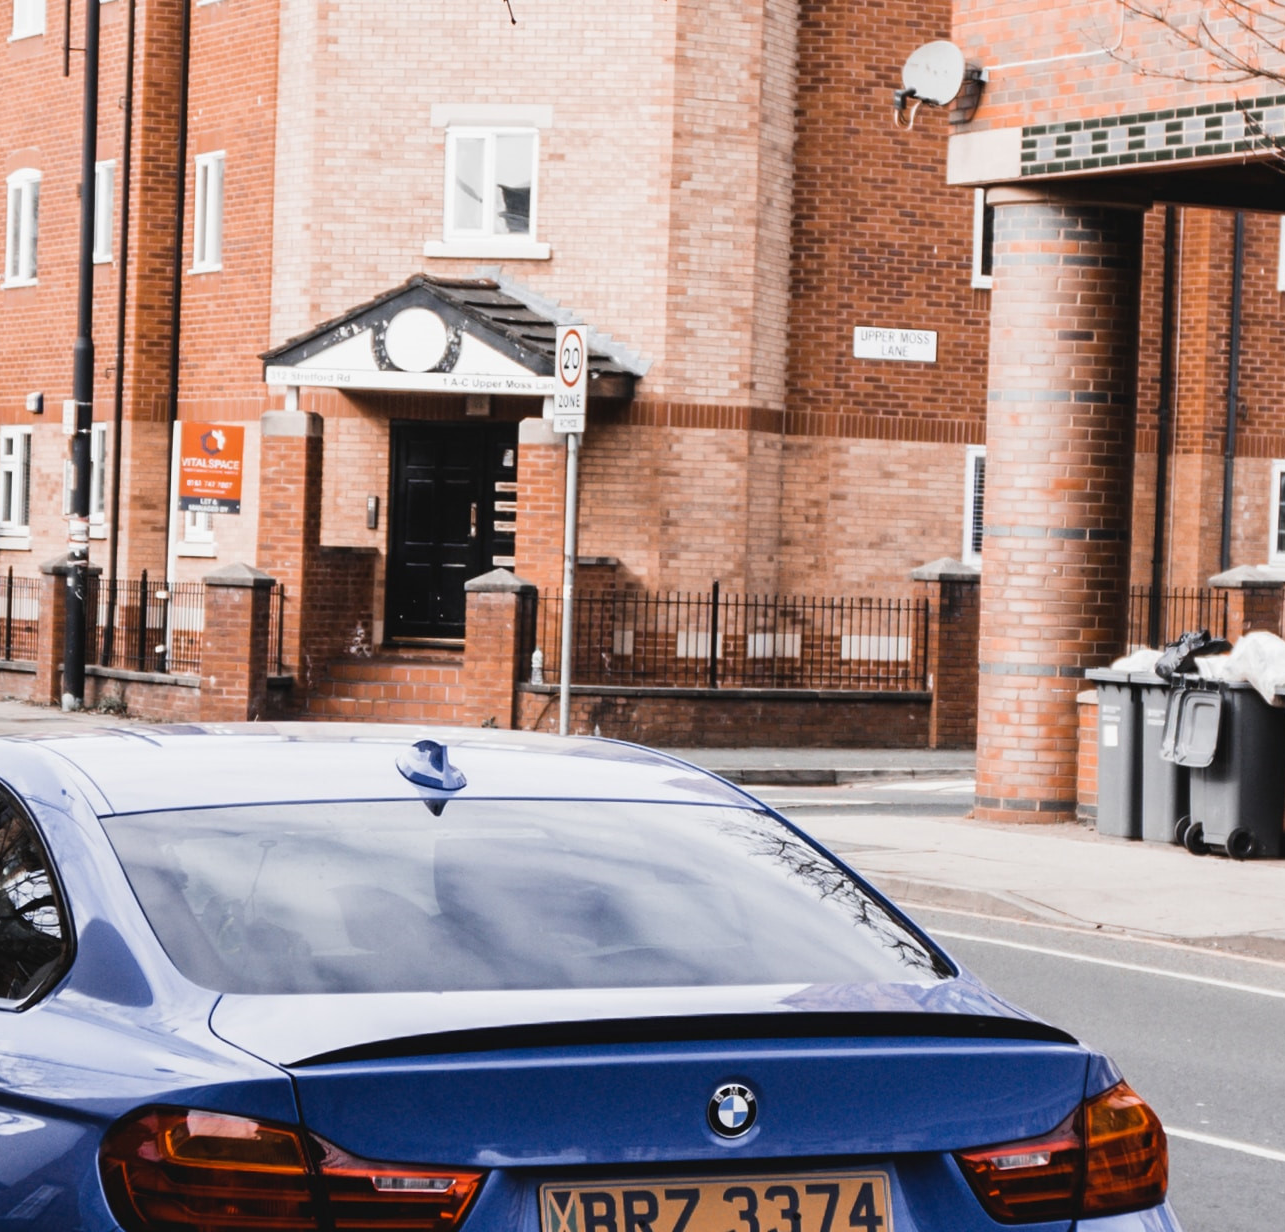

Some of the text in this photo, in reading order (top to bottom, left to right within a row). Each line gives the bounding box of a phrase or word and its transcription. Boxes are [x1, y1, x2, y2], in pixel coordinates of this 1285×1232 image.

[861, 330, 930, 345] UPPER MOSS
[881, 345, 910, 357] LANE
[563, 347, 580, 370] 20
[336, 374, 351, 383] Rd
[472, 379, 502, 390] Upper
[505, 380, 532, 390] Moss
[535, 381, 555, 390] Lan
[558, 394, 581, 408] ZONE
[182, 458, 240, 470] VITALSPACE
[579, 1182, 884, 1232] BRZ 3374
